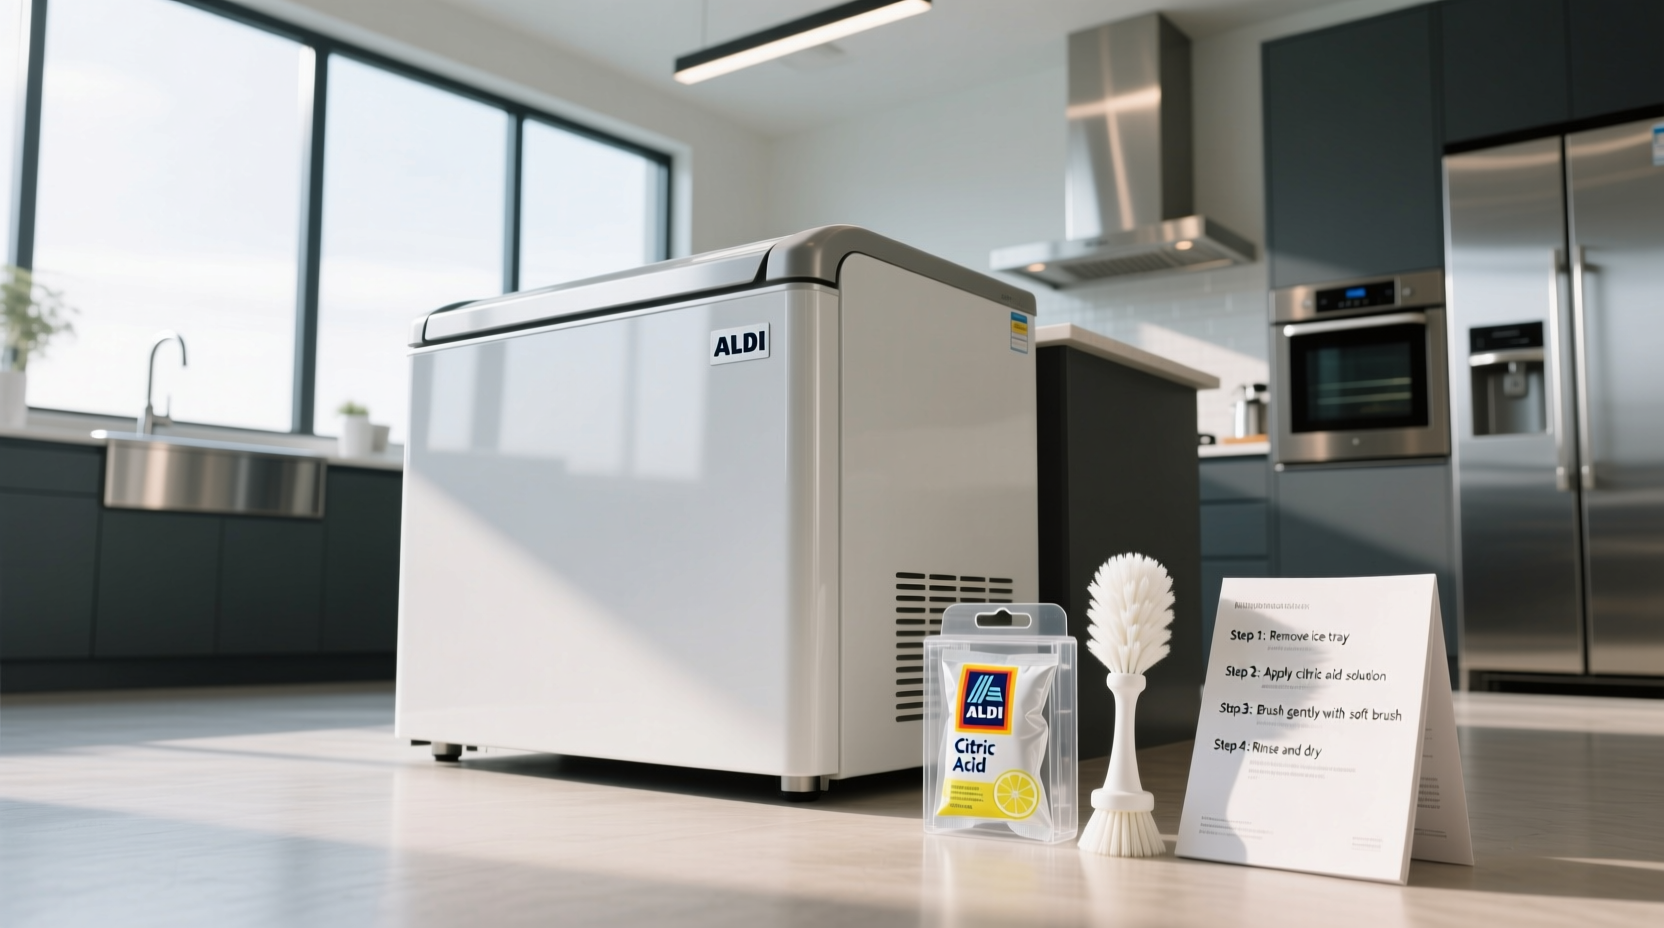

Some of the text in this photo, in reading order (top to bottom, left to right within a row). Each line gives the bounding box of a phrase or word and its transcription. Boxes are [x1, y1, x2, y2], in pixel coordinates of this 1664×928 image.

[713, 330, 766, 357] ALDI
[1230, 629, 1350, 645] Step 1: Remove ice tray
[1249, 665, 1261, 678] 2:
[1263, 666, 1293, 682] Apply
[1296, 667, 1322, 680] citric
[1325, 668, 1342, 680] aid
[966, 705, 1003, 719] ALDI
[1241, 702, 1253, 715] 3:
[1286, 706, 1320, 720] gently
[1322, 707, 1345, 719] with
[1349, 708, 1368, 720] soft
[1372, 708, 1402, 721] brush
[954, 738, 996, 756] Citric
[1213, 738, 1237, 754] Step
[1238, 740, 1251, 752] 4:
[1281, 743, 1302, 756] and
[1304, 744, 1322, 760] dry
[952, 756, 987, 773] Acid
